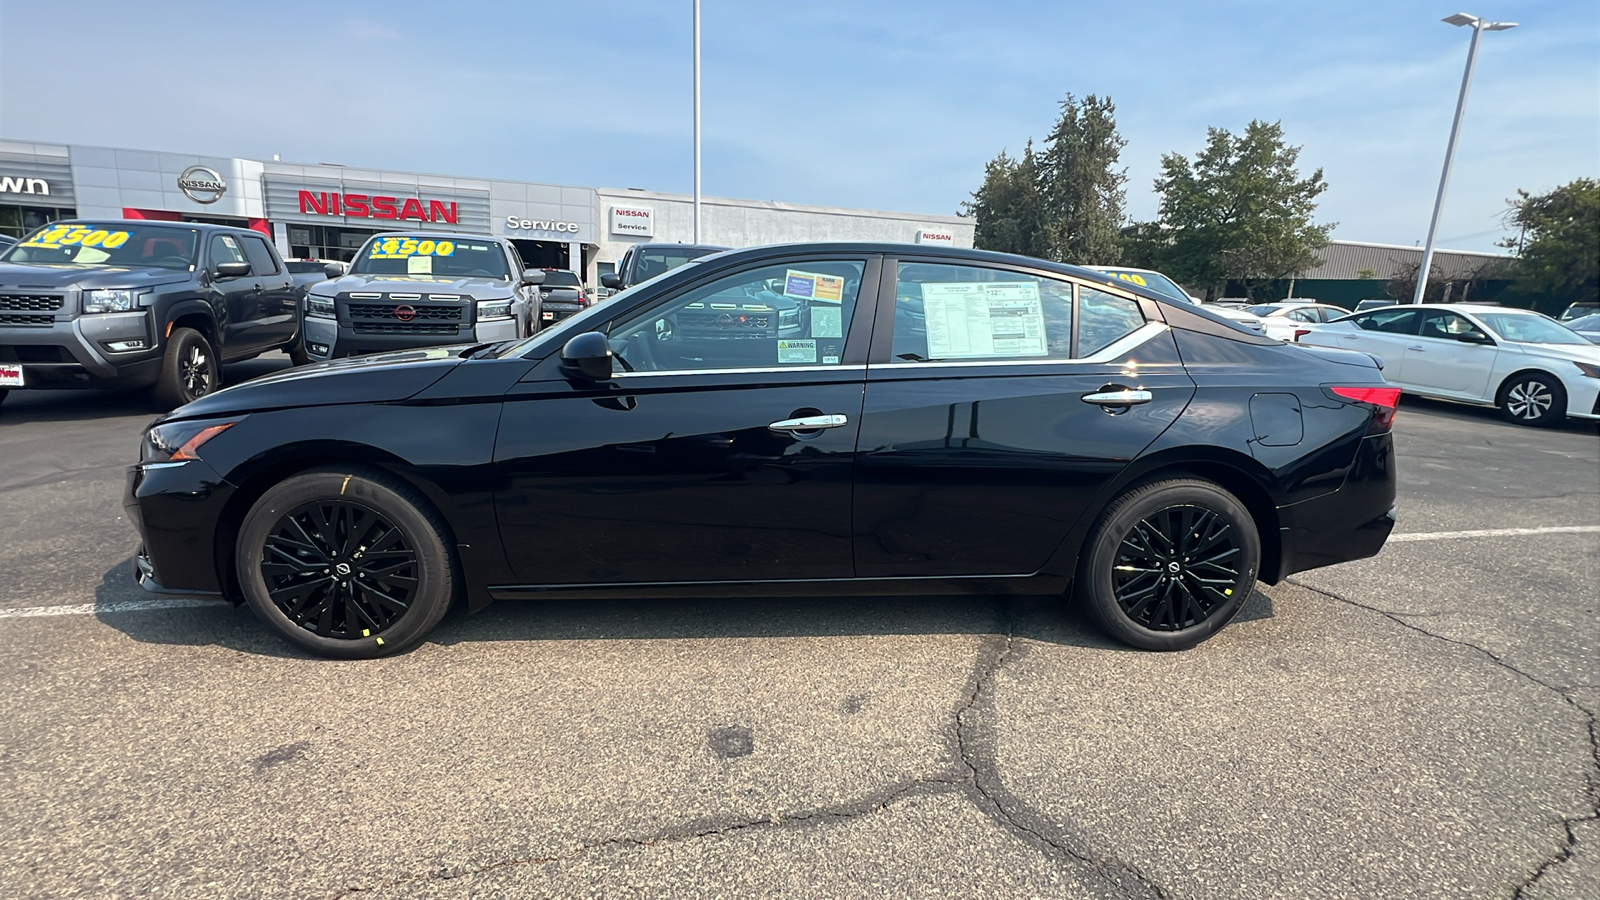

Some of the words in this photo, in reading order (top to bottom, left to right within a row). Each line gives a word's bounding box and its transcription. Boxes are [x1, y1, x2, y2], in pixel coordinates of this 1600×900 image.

[181, 180, 221, 189] NISSAN
[298, 190, 457, 224] NISSAN
[615, 209, 650, 218] NISSAN
[506, 215, 579, 233] Service
[618, 223, 647, 231] Service
[29, 228, 130, 248] $4500
[922, 233, 952, 241] NISSAN
[372, 240, 454, 256] $4500
